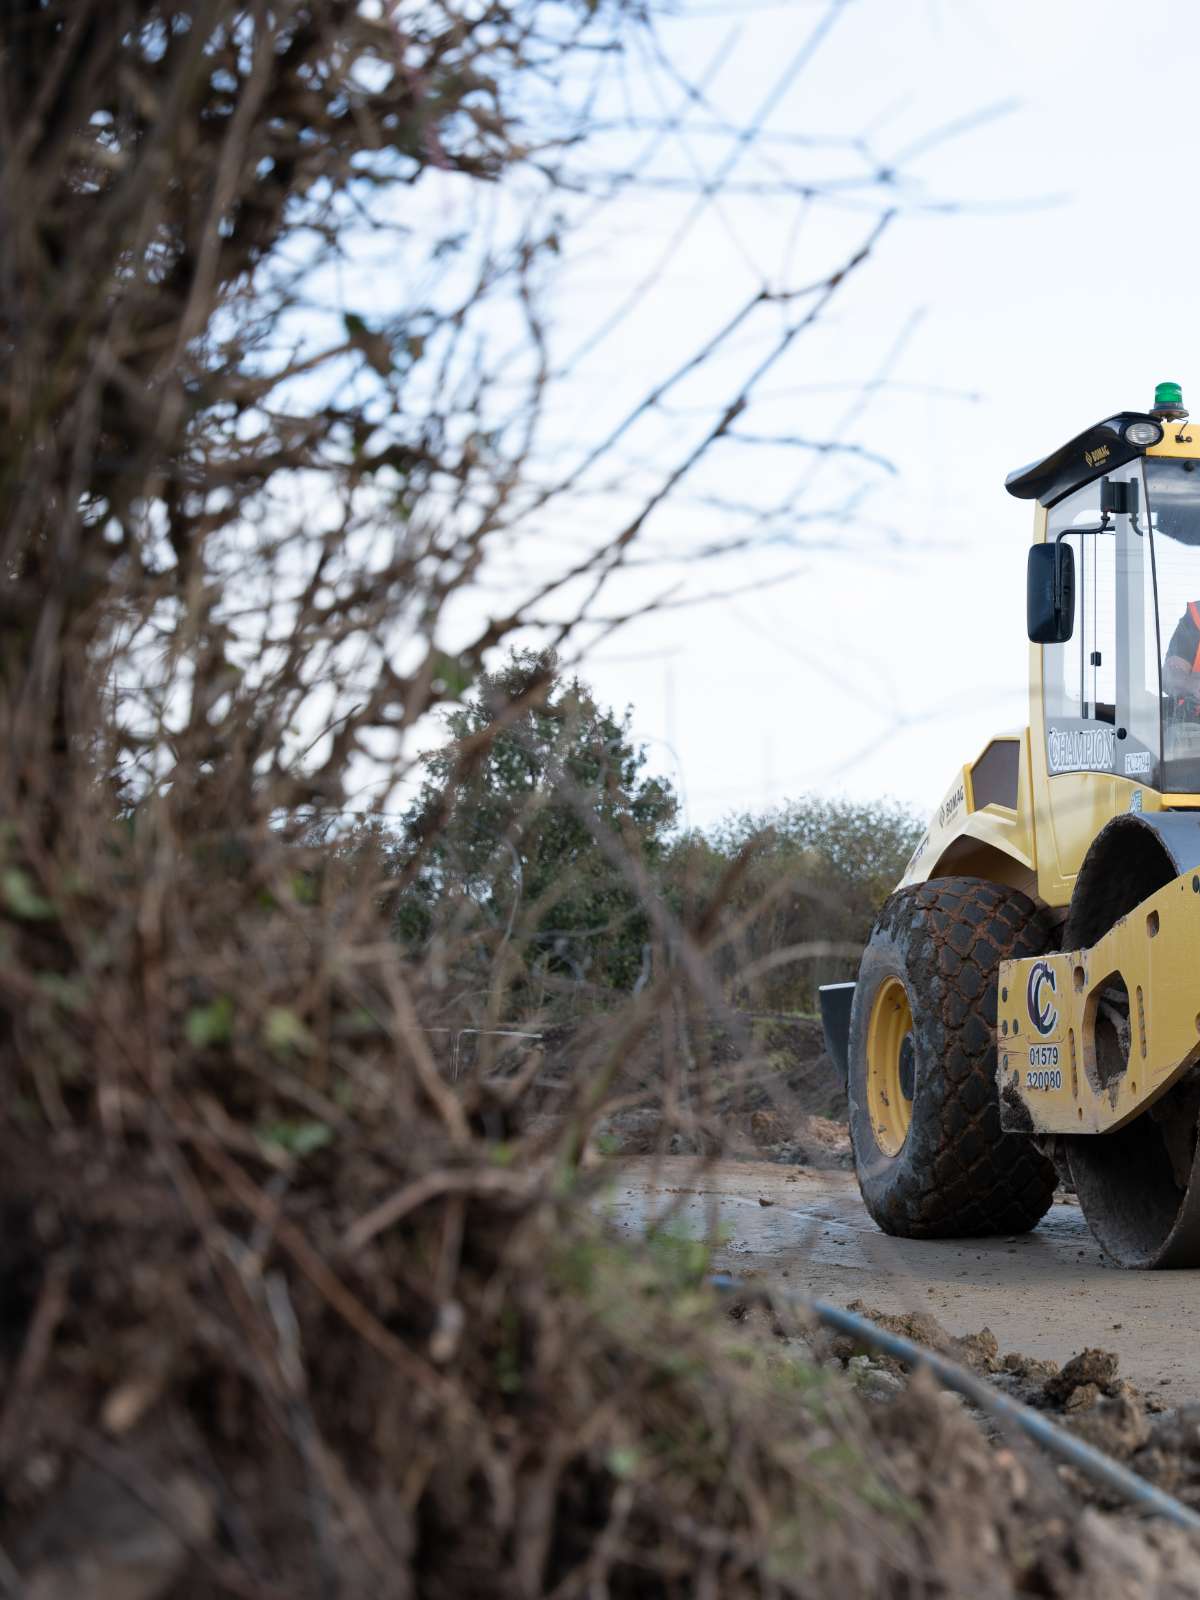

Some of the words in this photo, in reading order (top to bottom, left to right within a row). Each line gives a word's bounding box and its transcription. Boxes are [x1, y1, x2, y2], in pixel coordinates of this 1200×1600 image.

[1048, 728, 1115, 771] CHAMPION
[945, 784, 964, 818] BOMAG
[1029, 1046, 1059, 1066] 01579
[1026, 1069, 1062, 1089] 320080
